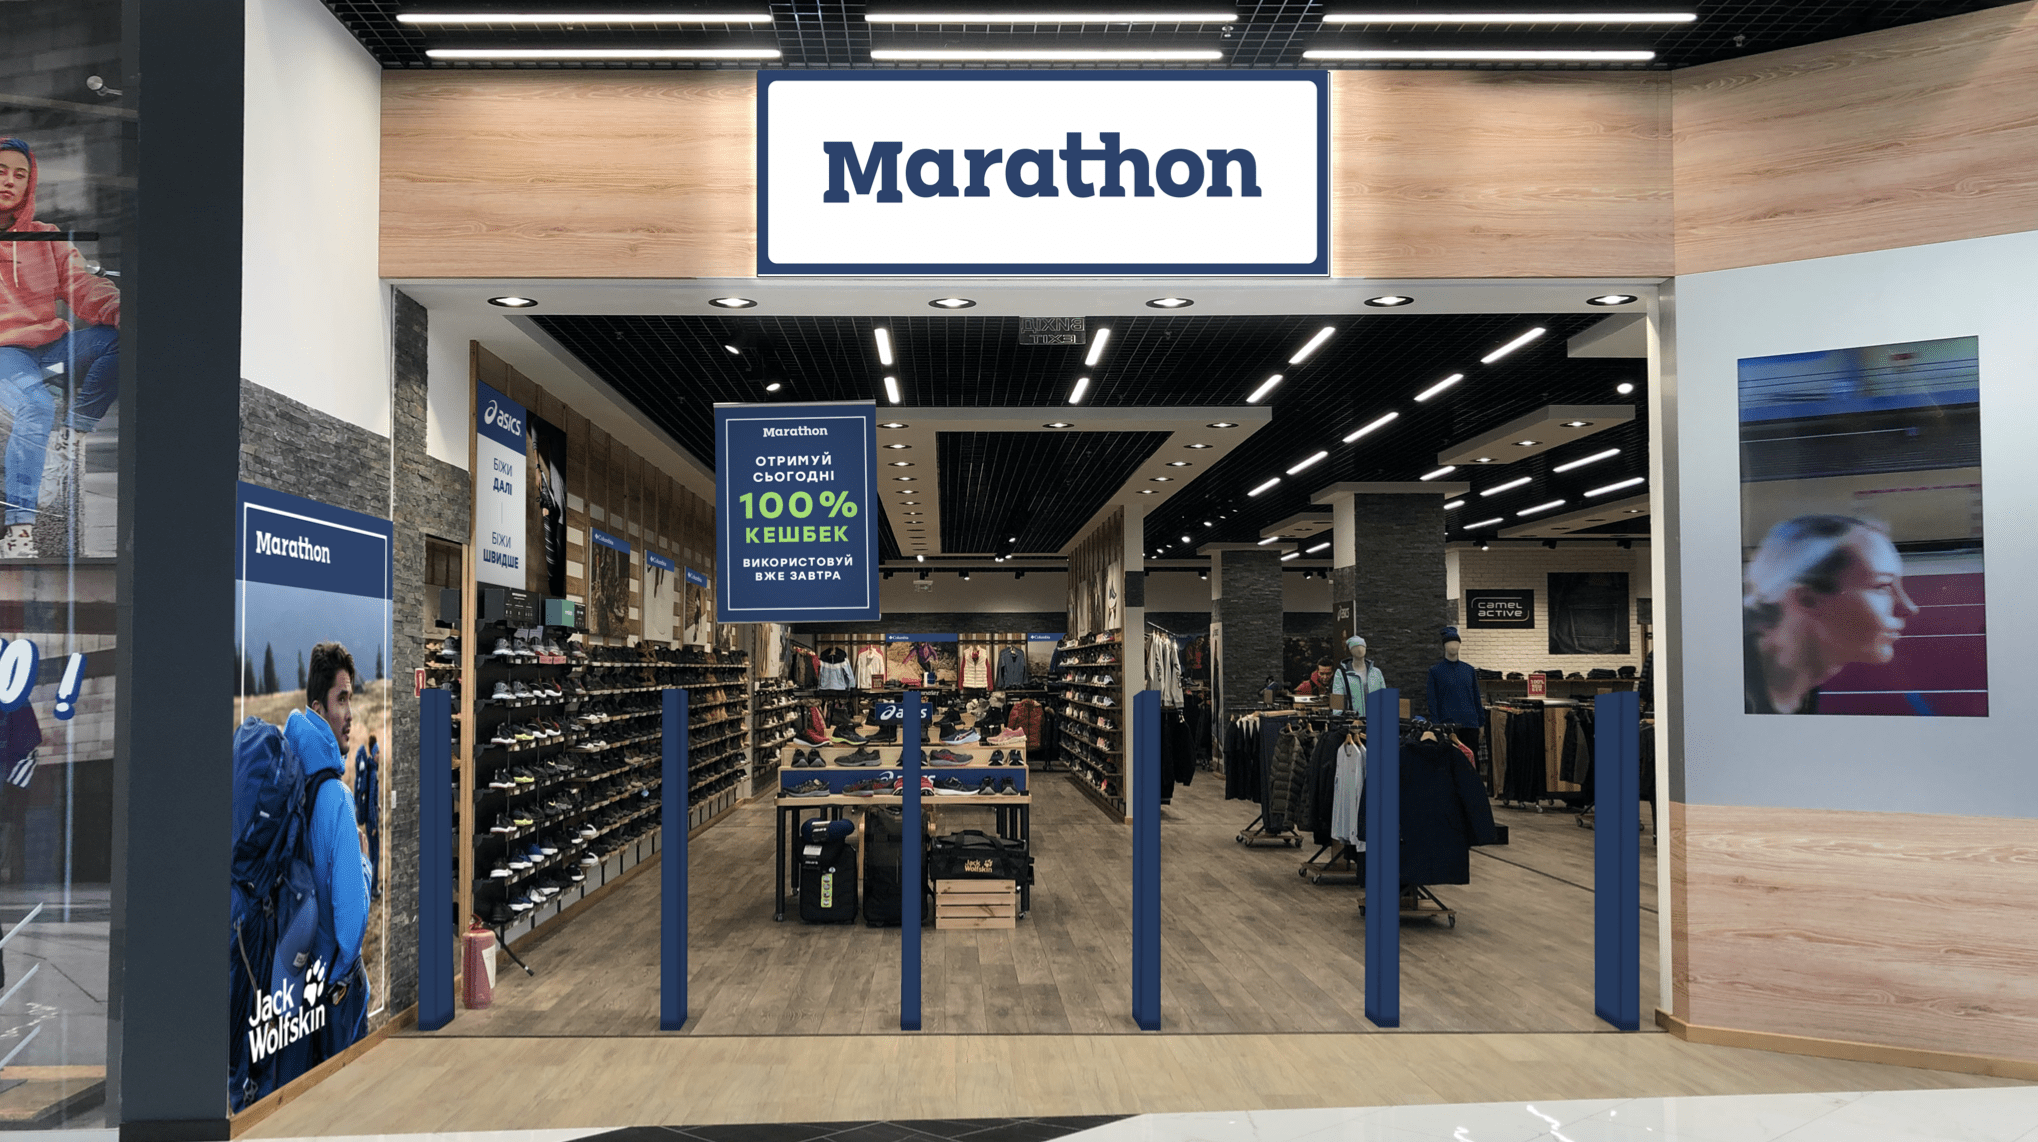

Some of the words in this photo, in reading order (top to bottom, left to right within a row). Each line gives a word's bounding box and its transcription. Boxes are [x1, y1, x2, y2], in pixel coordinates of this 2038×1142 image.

[823, 131, 1263, 203] Marathon
[496, 409, 523, 437] asics
[762, 425, 829, 438] Marathon
[493, 457, 513, 478] БІЖИ
[755, 451, 832, 467] ОТРИМУЙ
[752, 470, 835, 483] СЬОГОДНІ
[492, 477, 513, 496] ДАЛІ
[739, 490, 858, 520] 100%
[491, 531, 512, 549] БІЖИ
[745, 525, 850, 544] КЕШБЕК
[255, 530, 331, 564] Marathon
[482, 548, 519, 570] ШВИДШЕ
[742, 553, 854, 568] ВИКОРИСТОВУЙ
[754, 571, 785, 582] ВЖЕ
[789, 570, 842, 581] ЗАВТРА
[964, 864, 993, 873] Wolfskin
[248, 977, 296, 1028] Jack
[248, 1003, 326, 1064] Wolfskin
